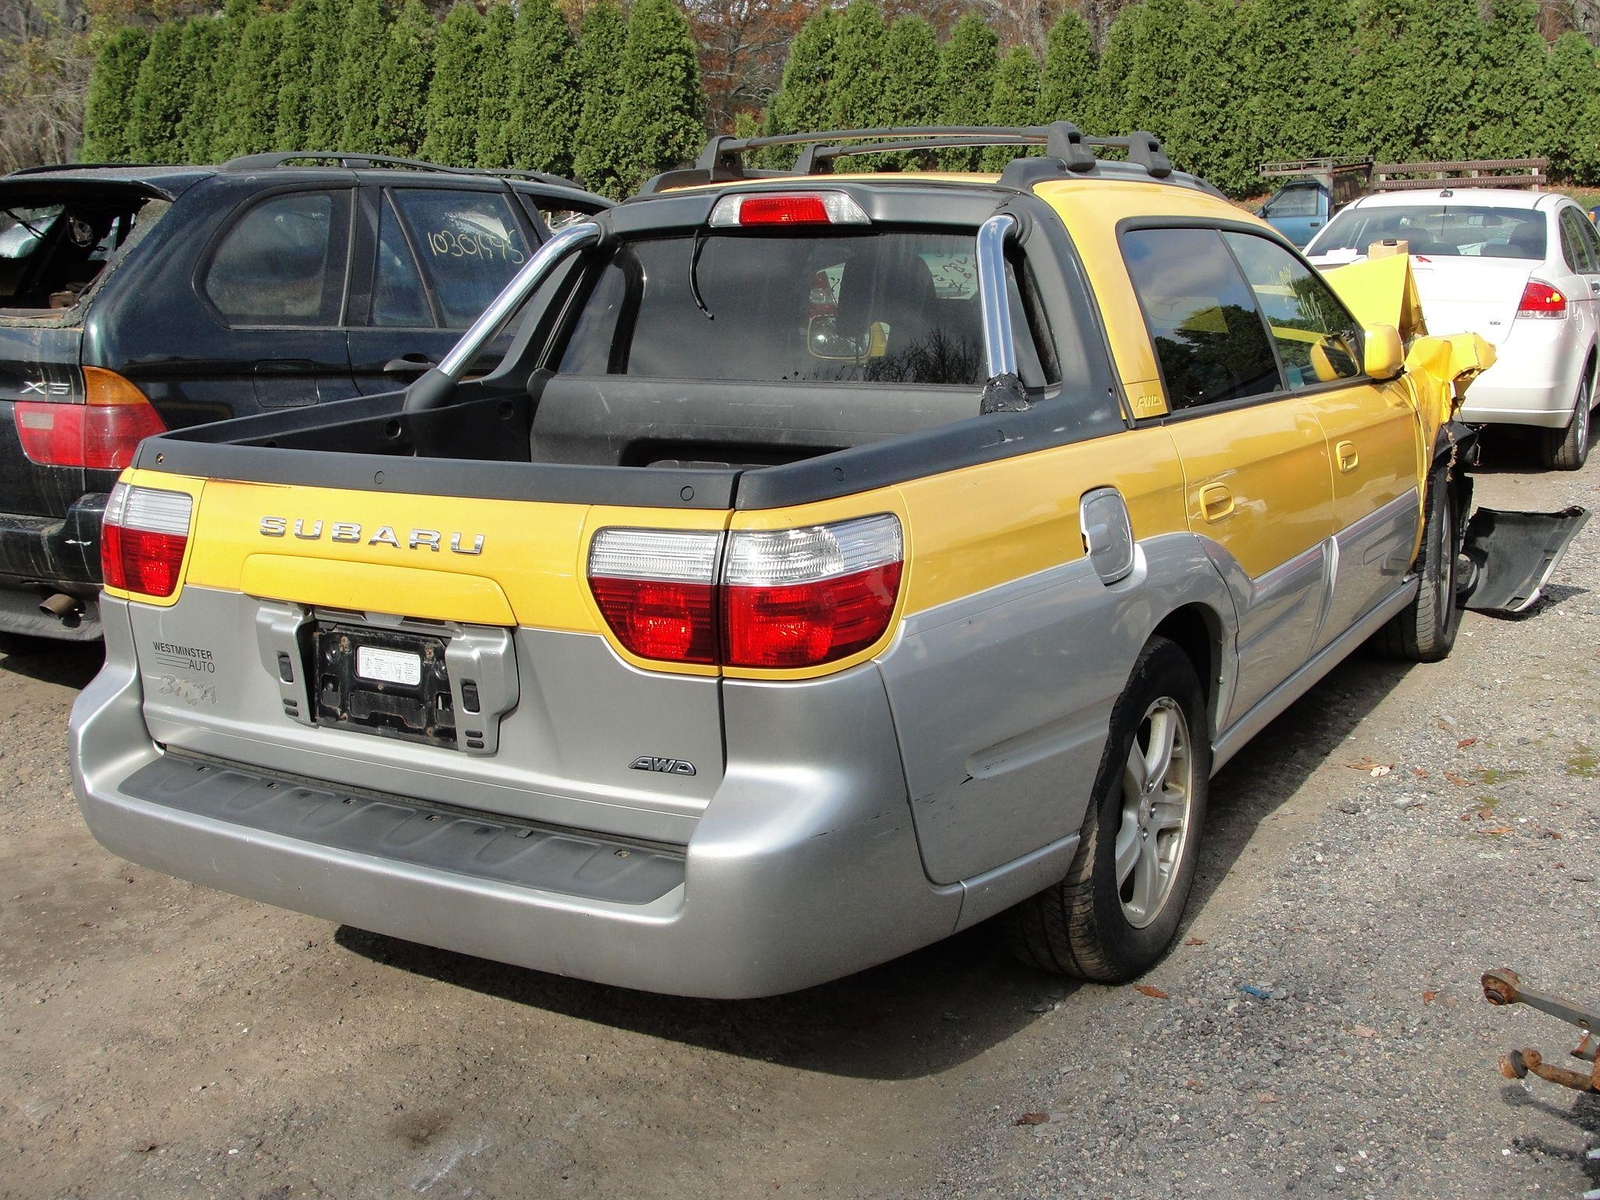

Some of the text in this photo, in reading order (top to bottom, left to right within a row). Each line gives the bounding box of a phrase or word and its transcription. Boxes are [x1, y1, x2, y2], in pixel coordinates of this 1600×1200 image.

[259, 515, 486, 555] SUBARU
[152, 641, 214, 660] WESTMINSTER
[188, 659, 216, 674] AUTO
[627, 755, 697, 777] AWD
